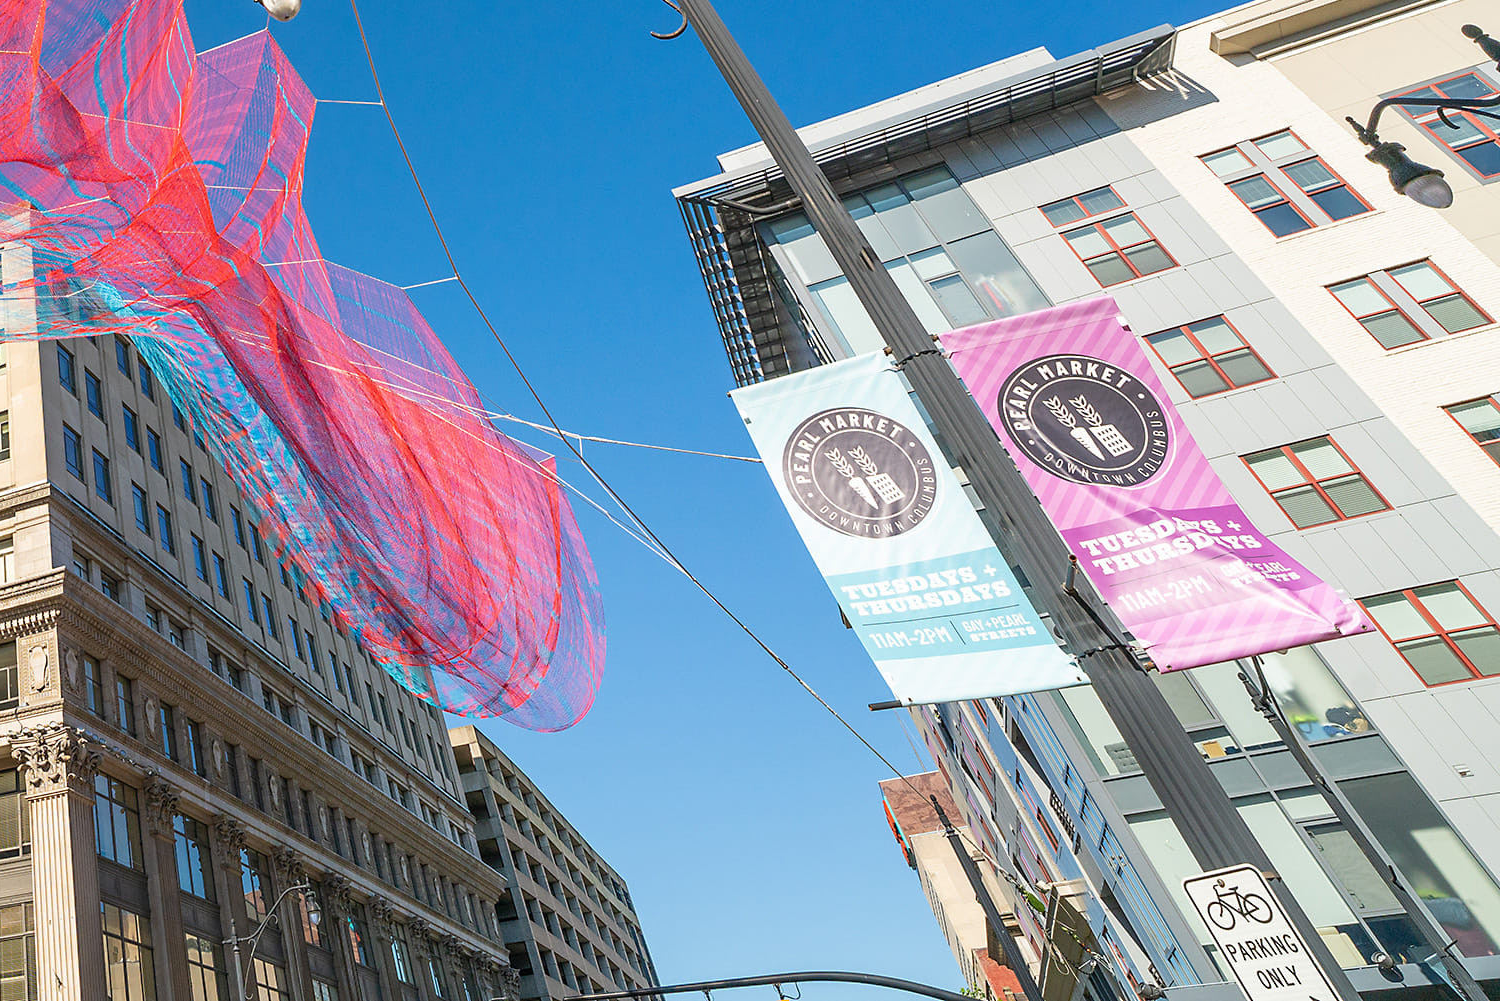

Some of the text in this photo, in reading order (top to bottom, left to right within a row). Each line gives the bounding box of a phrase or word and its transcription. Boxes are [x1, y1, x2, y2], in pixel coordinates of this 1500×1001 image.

[1009, 360, 1131, 431] PEARL MARKET
[793, 413, 903, 484] PEARL MARKET
[1043, 410, 1167, 485] DOWNTOWN COLUMBUS
[820, 457, 935, 535] DOWNTOWN COLUMBUS
[840, 566, 978, 600] TUESDAYS
[849, 580, 1012, 616] THURSDAYS
[869, 626, 954, 649] 11AM-2PM
[969, 626, 1037, 642] STREETS
[1225, 934, 1298, 962] PARKING
[1257, 965, 1302, 989] ONLY
